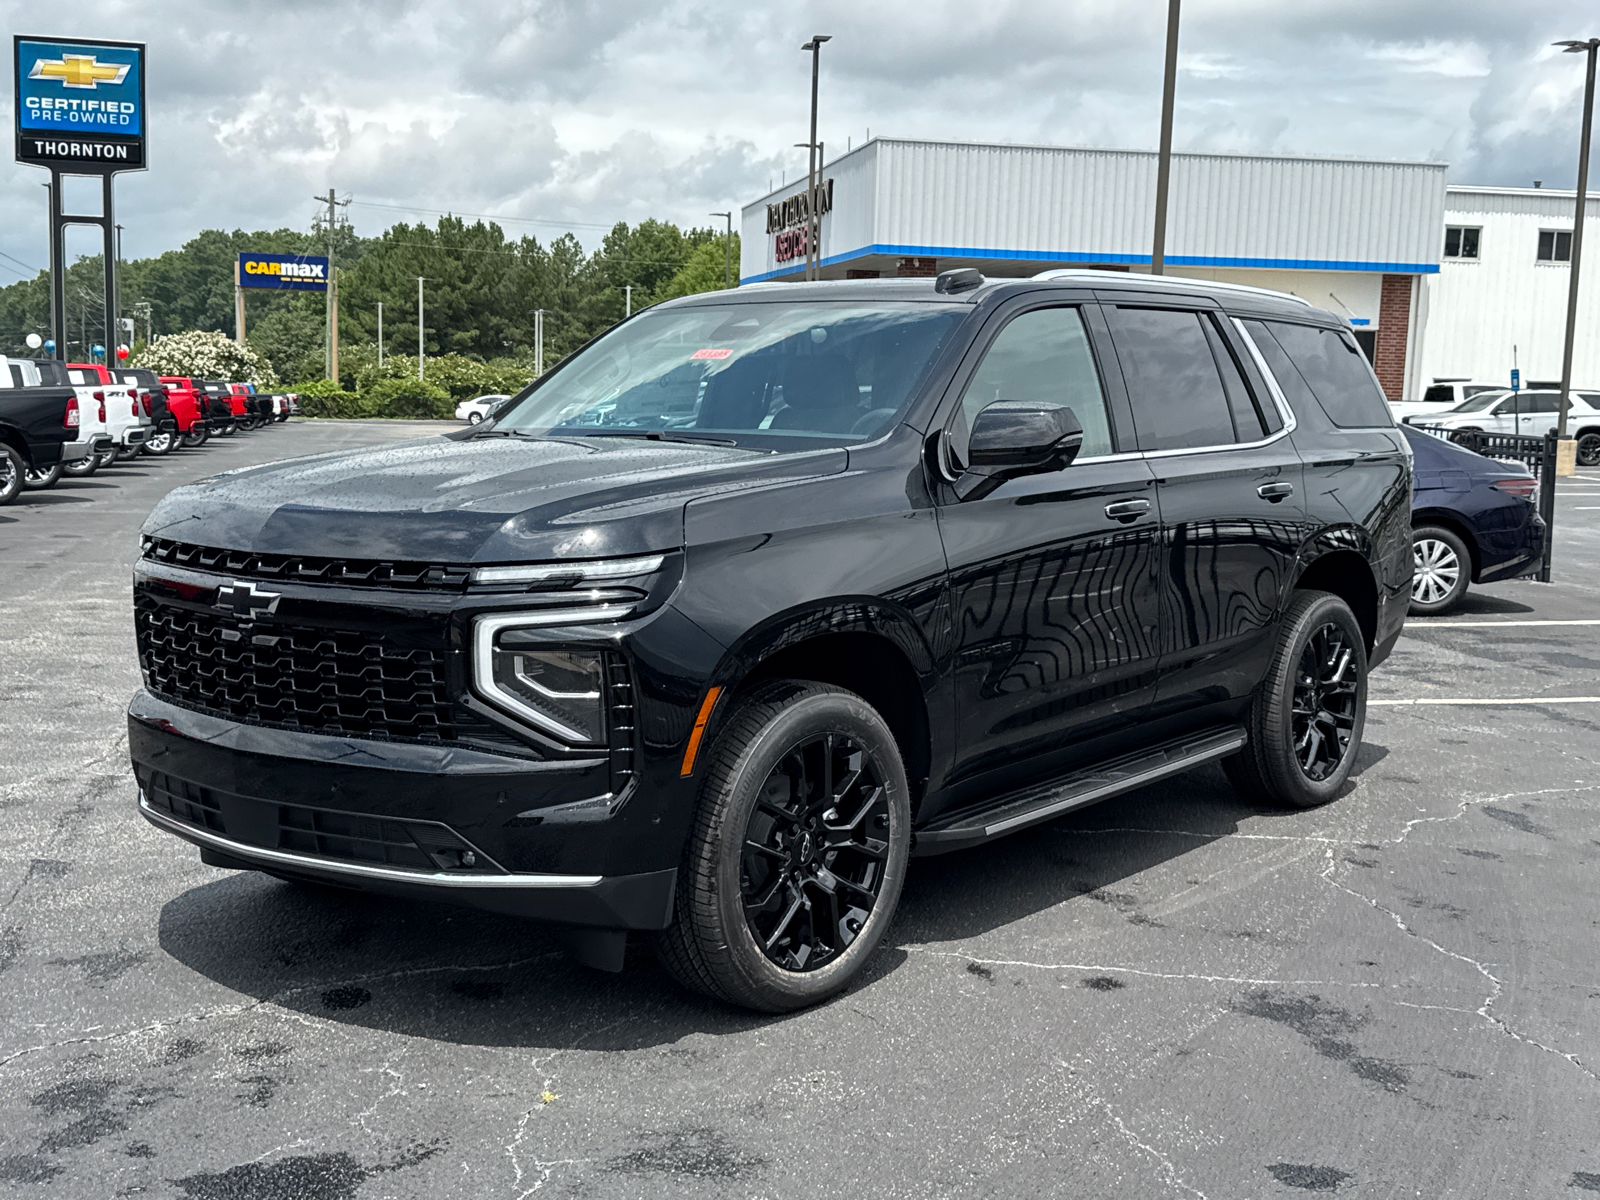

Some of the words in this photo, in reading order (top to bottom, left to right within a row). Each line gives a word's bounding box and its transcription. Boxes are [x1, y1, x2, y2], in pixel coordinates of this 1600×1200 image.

[26, 97, 135, 114] CERTIFIED
[31, 110, 129, 125] PRE-OWNED
[35, 141, 127, 158] THORNTON
